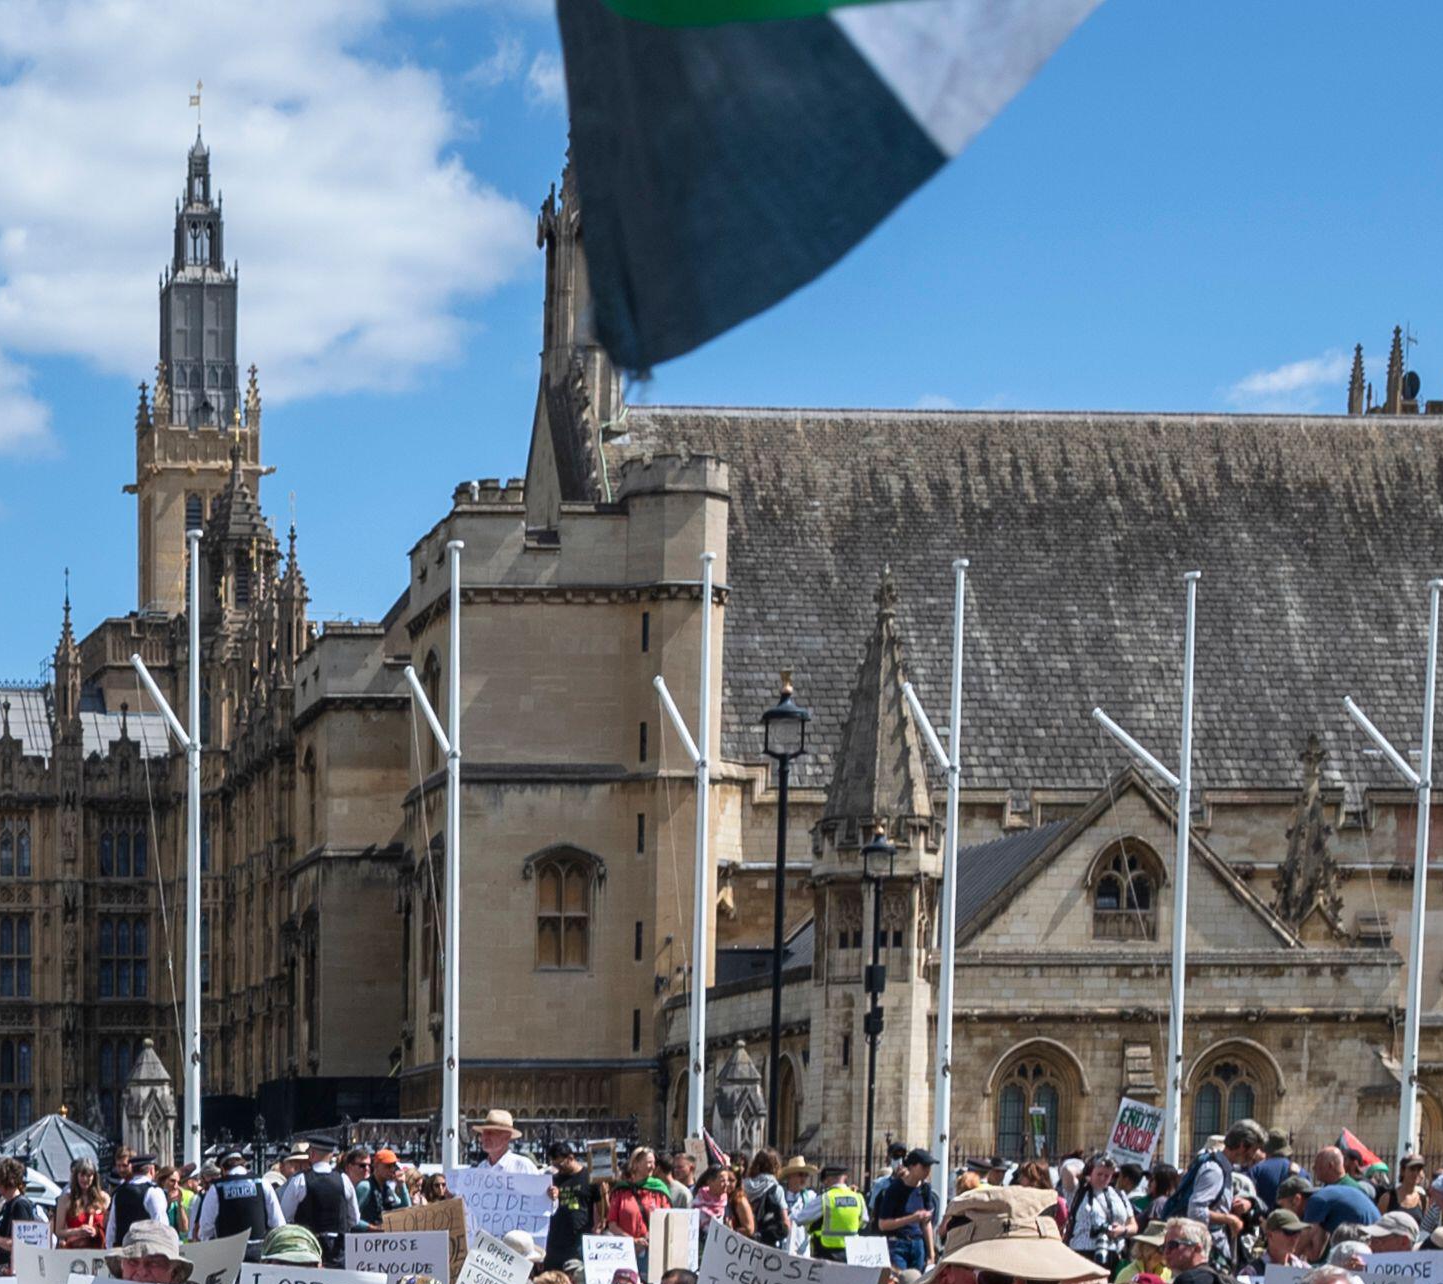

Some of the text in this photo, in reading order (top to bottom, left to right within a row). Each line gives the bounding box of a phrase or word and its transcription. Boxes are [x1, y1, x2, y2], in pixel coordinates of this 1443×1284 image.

[353, 1238, 419, 1253] I OPPOSE
[487, 1242, 515, 1265] OPPOSE
[475, 1254, 515, 1282] GENOCIDE
[725, 1233, 824, 1284] OPPOSE
[356, 1262, 435, 1276] GENOCIDE
[1374, 1261, 1433, 1278] OPPOSE
